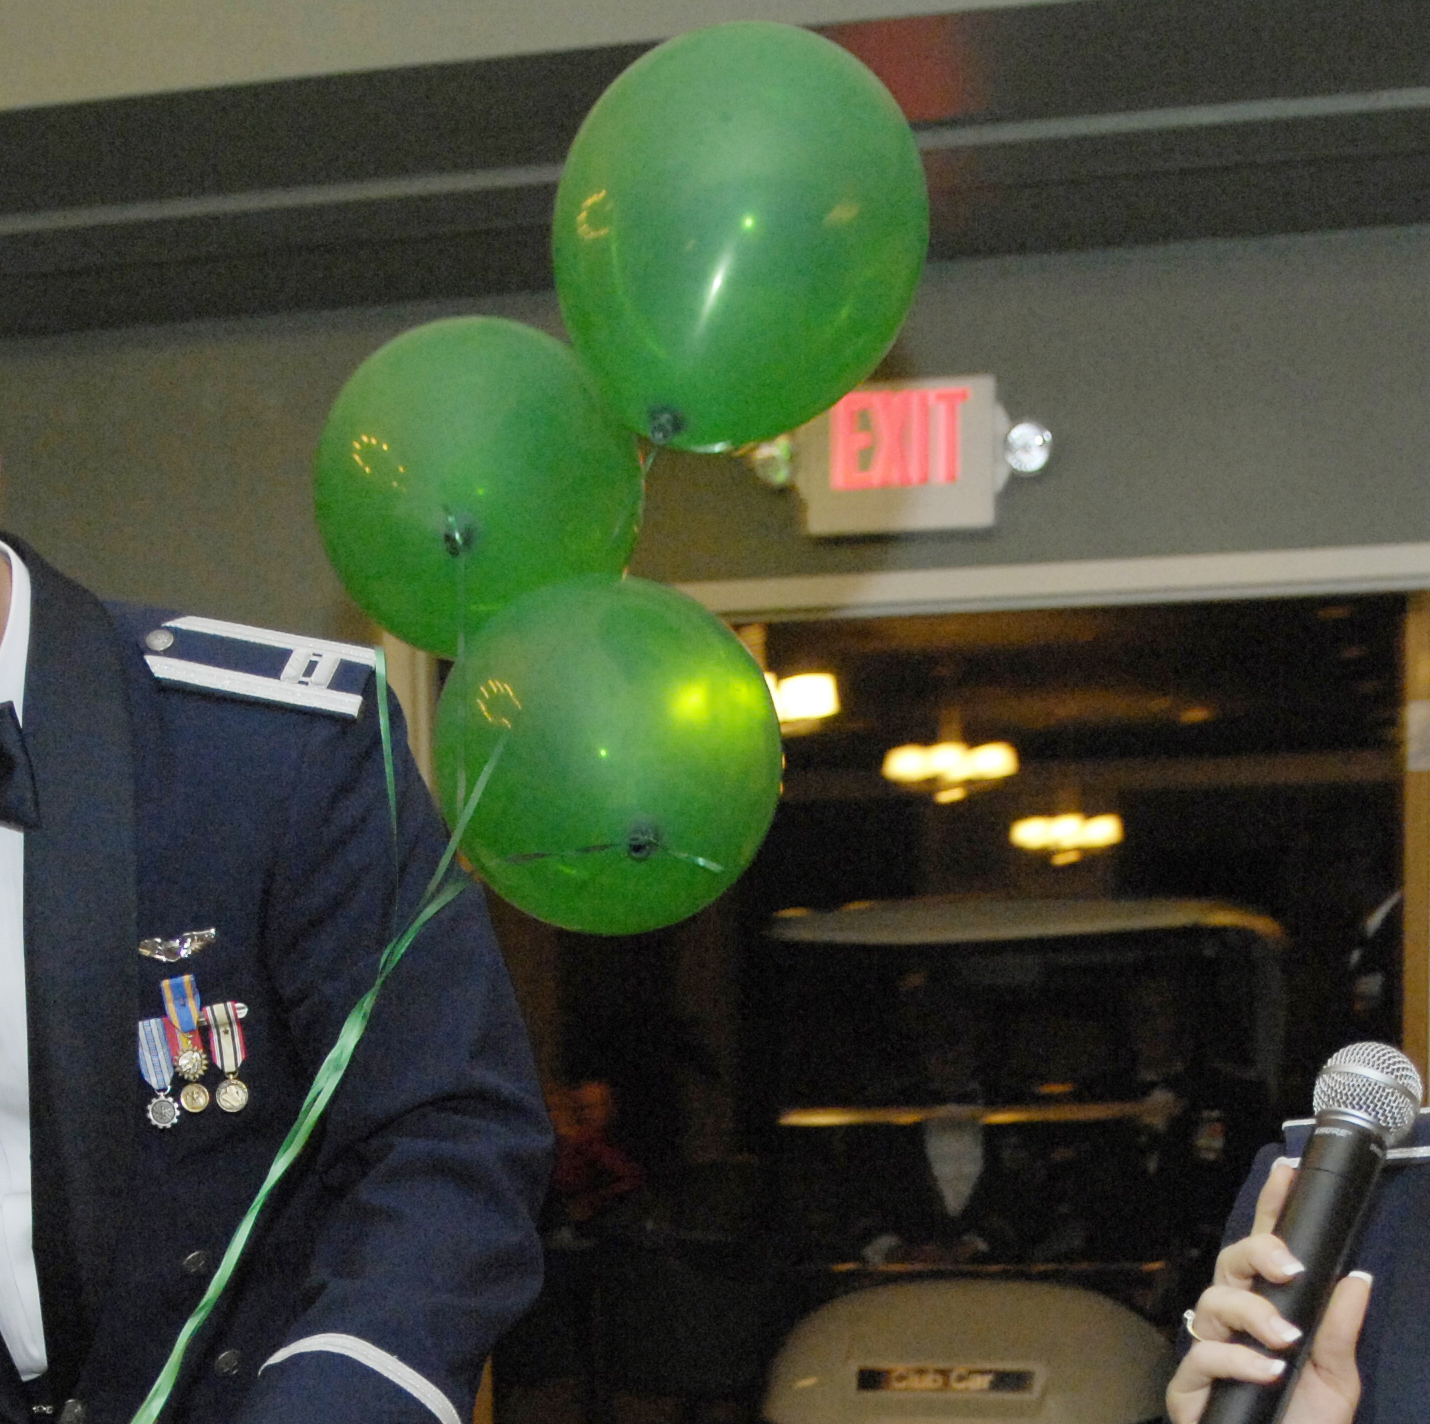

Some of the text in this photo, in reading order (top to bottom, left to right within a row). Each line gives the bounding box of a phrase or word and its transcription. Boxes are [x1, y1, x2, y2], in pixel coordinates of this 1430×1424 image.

[828, 386, 972, 492] EXIT
[891, 1367, 994, 1391] Club Car
